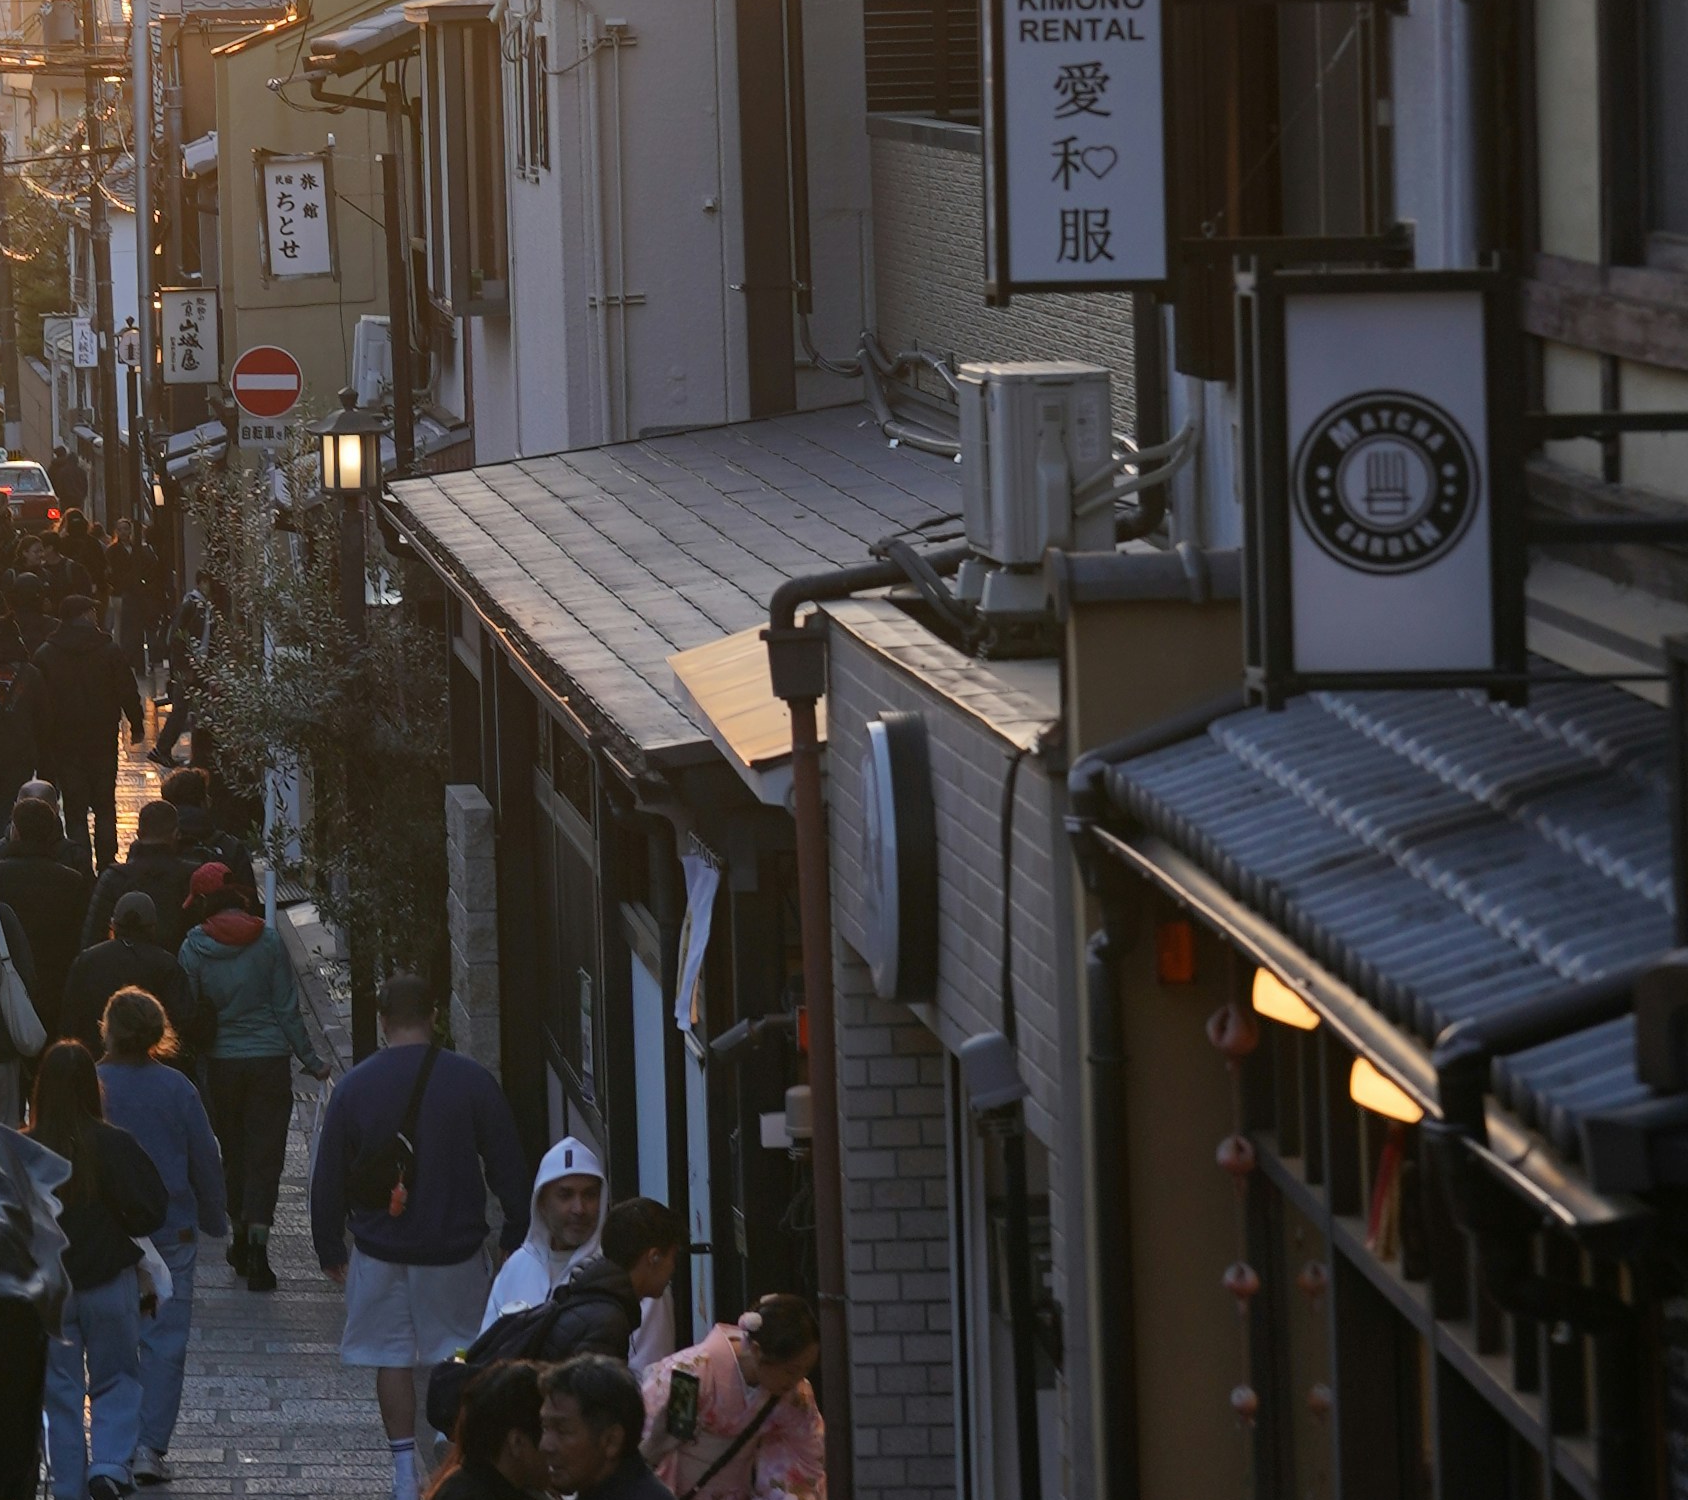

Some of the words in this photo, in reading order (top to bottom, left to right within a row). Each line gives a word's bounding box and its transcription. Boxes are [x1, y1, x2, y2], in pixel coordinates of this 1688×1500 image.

[1019, 17, 1145, 43] RENTAL
[300, 172, 320, 219] 旅館
[276, 191, 301, 259] ちとせ
[1327, 408, 1446, 451] MATCHA
[1334, 518, 1442, 557] GARDEN
